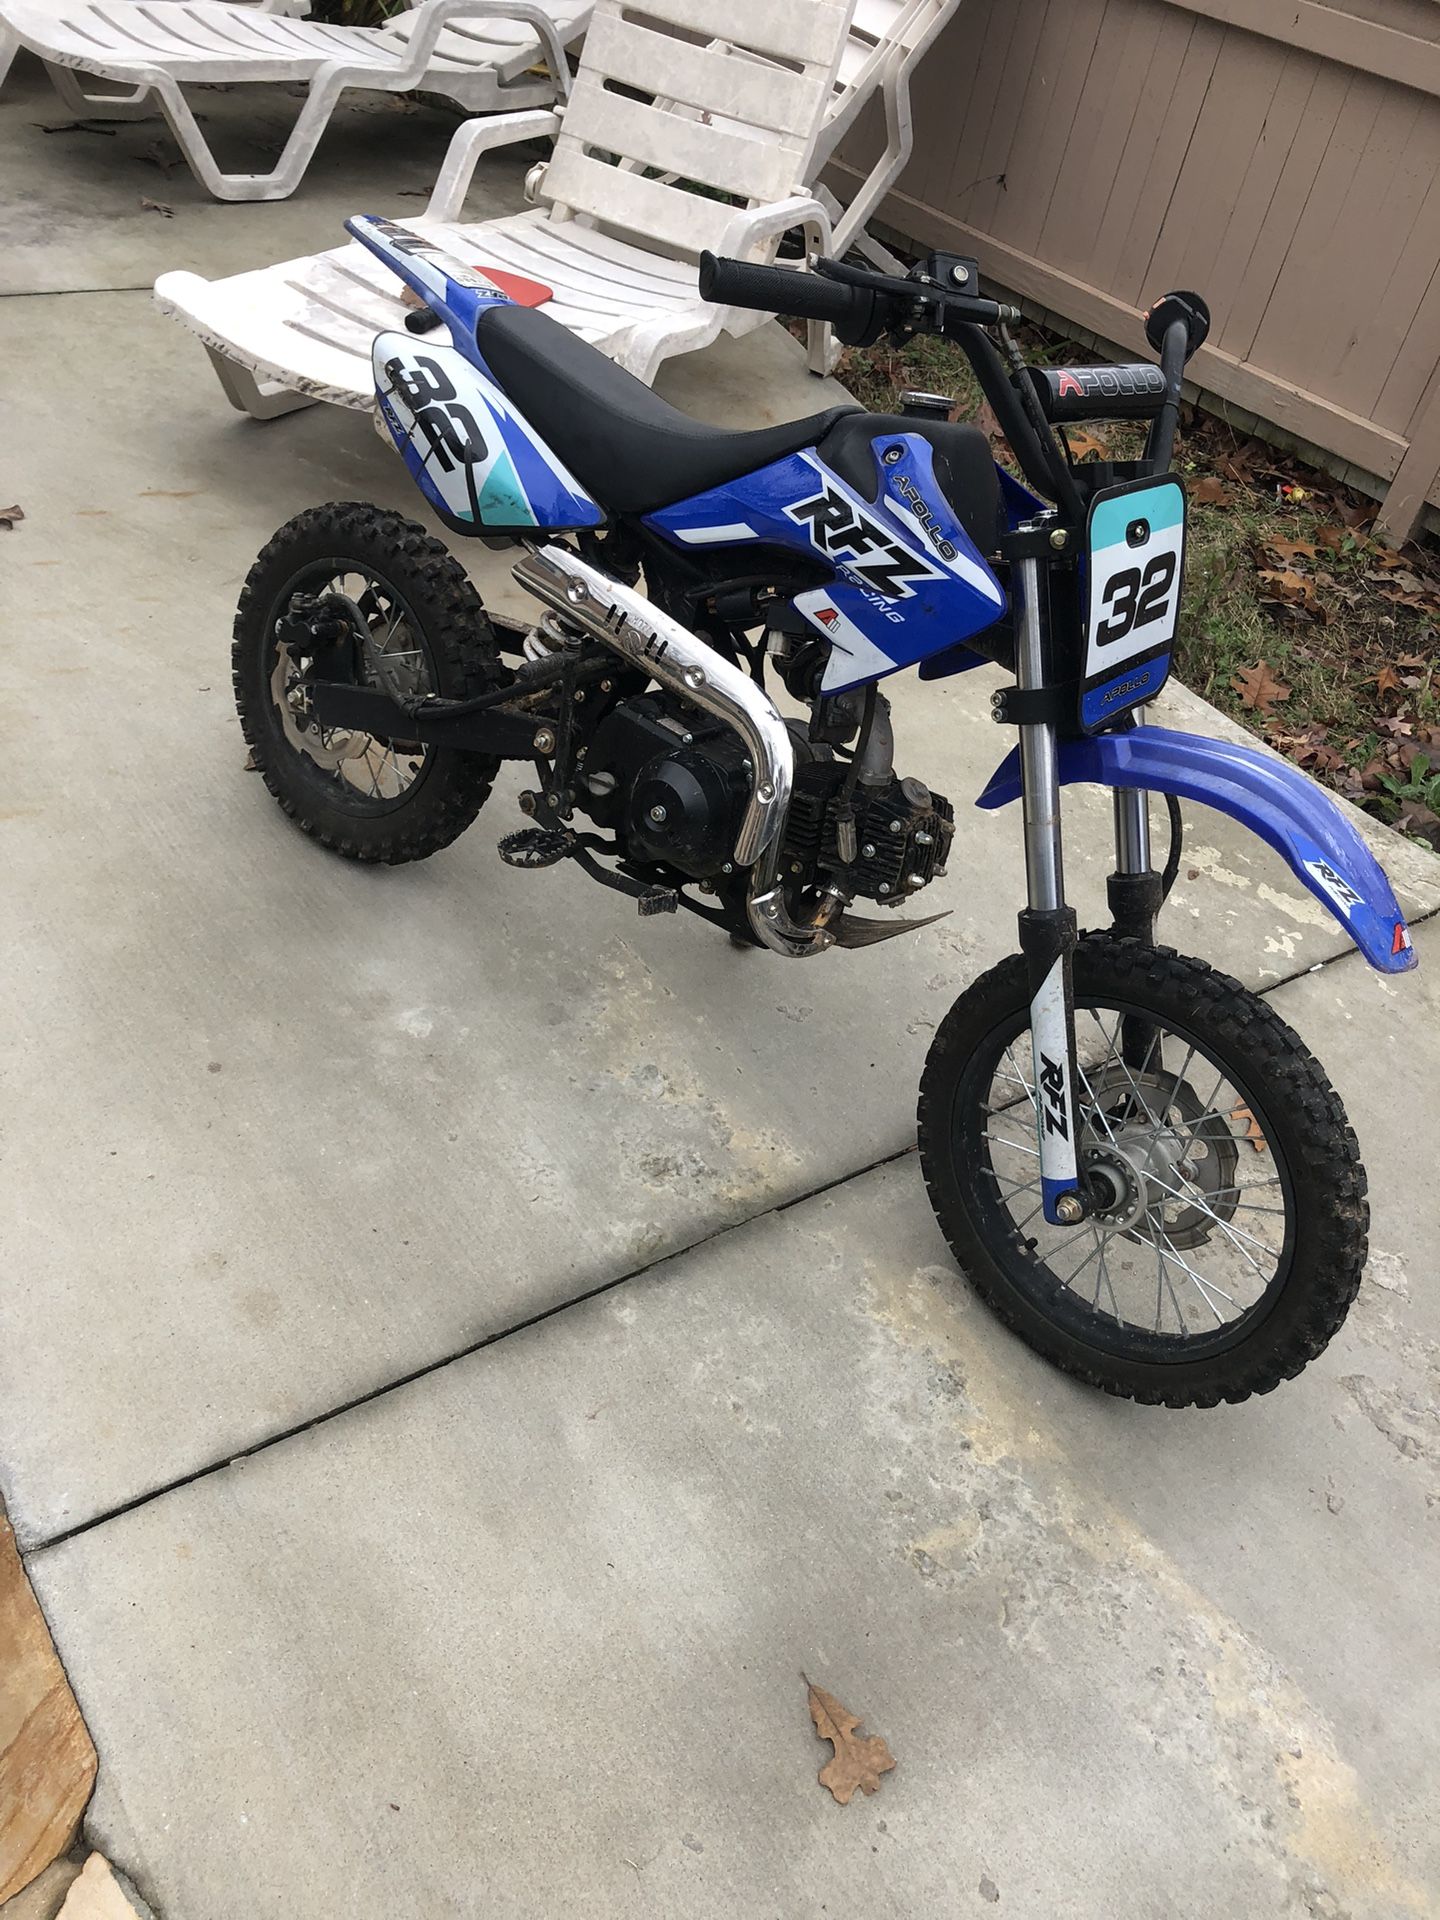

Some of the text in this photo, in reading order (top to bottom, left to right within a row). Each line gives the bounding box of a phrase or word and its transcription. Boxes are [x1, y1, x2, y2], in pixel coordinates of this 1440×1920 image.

[385, 355, 488, 473] 32
[1057, 366, 1164, 397] APOLLO
[791, 486, 934, 599] RFZ
[891, 475, 958, 562] APOLLO
[1096, 550, 1176, 647] 32
[1101, 671, 1150, 706] APOLLO
[1311, 863, 1361, 903] RFZ
[1040, 1050, 1069, 1142] RFZ
